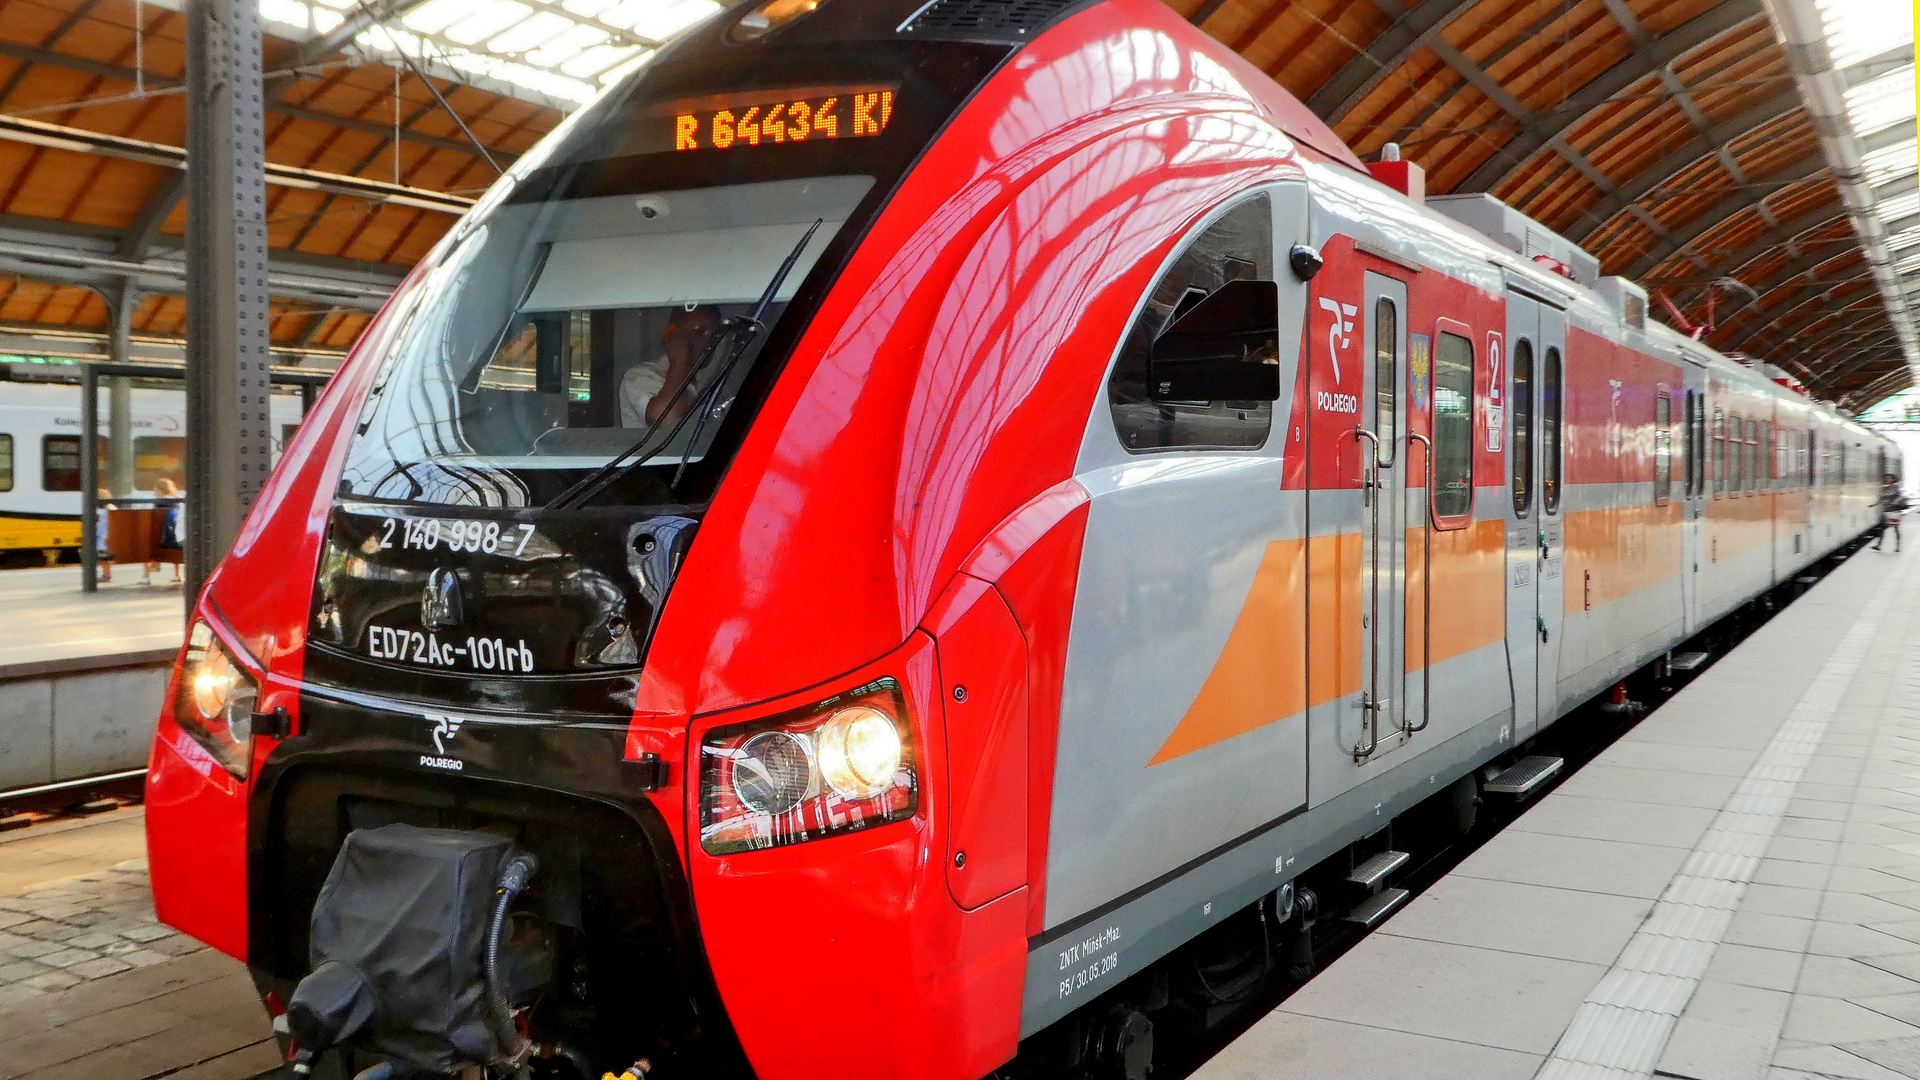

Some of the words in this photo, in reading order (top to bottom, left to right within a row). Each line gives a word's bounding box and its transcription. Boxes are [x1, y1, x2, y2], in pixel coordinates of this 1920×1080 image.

[676, 114, 698, 150] R
[711, 97, 838, 149] 64434
[1490, 340, 1499, 399] 2
[1317, 391, 1357, 414] POLREGIO
[380, 518, 396, 549] 2
[403, 518, 441, 550] 140
[448, 520, 536, 556] 998-7
[369, 625, 534, 673] ED72Ac-101rb
[420, 755, 463, 771] POLREGIO
[1059, 943, 1080, 970] ZNTK
[1076, 951, 1118, 989] 30.05.2018
